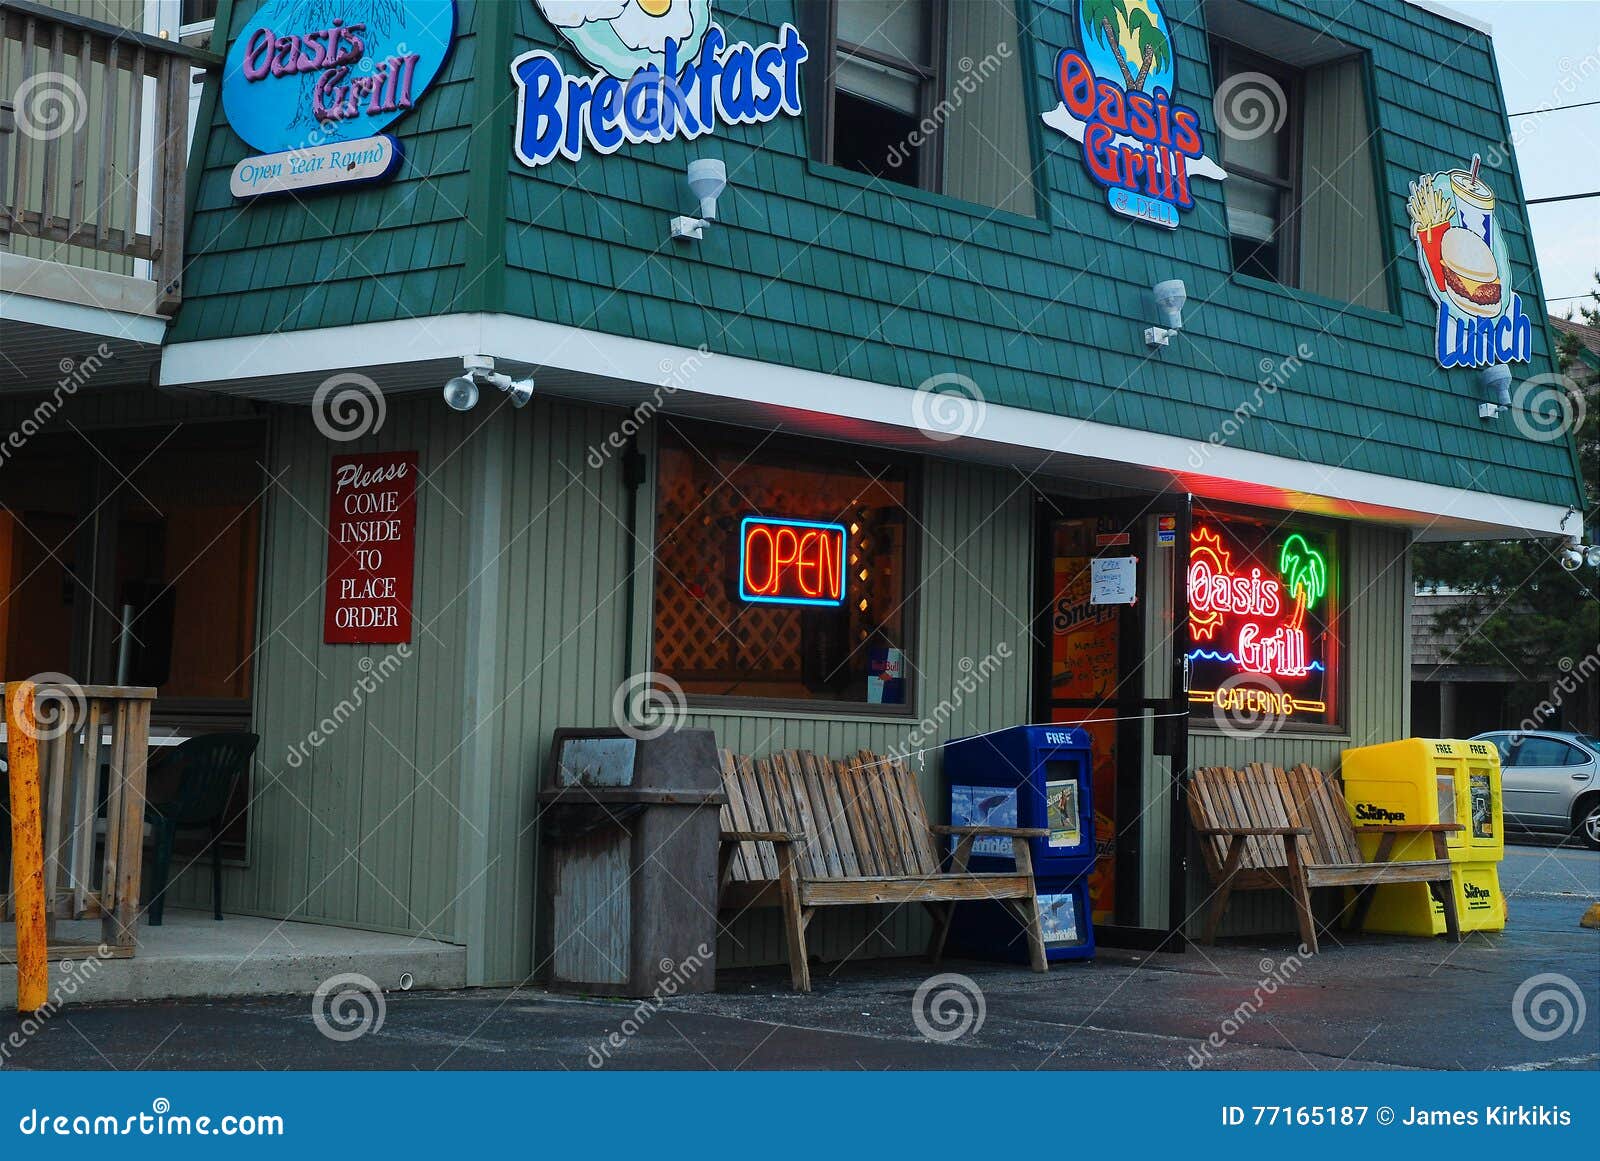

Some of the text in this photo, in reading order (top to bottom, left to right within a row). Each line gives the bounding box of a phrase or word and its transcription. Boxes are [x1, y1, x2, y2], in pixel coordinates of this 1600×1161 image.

[243, 18, 366, 83] Oasis
[313, 54, 420, 122] Grill
[515, 26, 807, 161] Breakfast
[1059, 53, 1202, 153] Oasis
[239, 143, 384, 187] Open Year Round
[1085, 122, 1191, 204] Grill
[1137, 196, 1171, 225] DELI
[1438, 293, 1531, 368] Lunch
[336, 462, 408, 495] Please
[344, 491, 399, 515] COME
[340, 519, 401, 543] INSIDE
[356, 549, 382, 571] TO
[744, 527, 842, 599] OPEN
[340, 577, 396, 600] PLACE
[1187, 560, 1280, 617] Oasis
[335, 606, 399, 628] ORDER
[1239, 623, 1307, 677] Grill
[1216, 687, 1294, 715] CATERING
[1046, 732, 1073, 745] FREE
[1435, 744, 1453, 755] FREE
[1470, 744, 1488, 755] FREE
